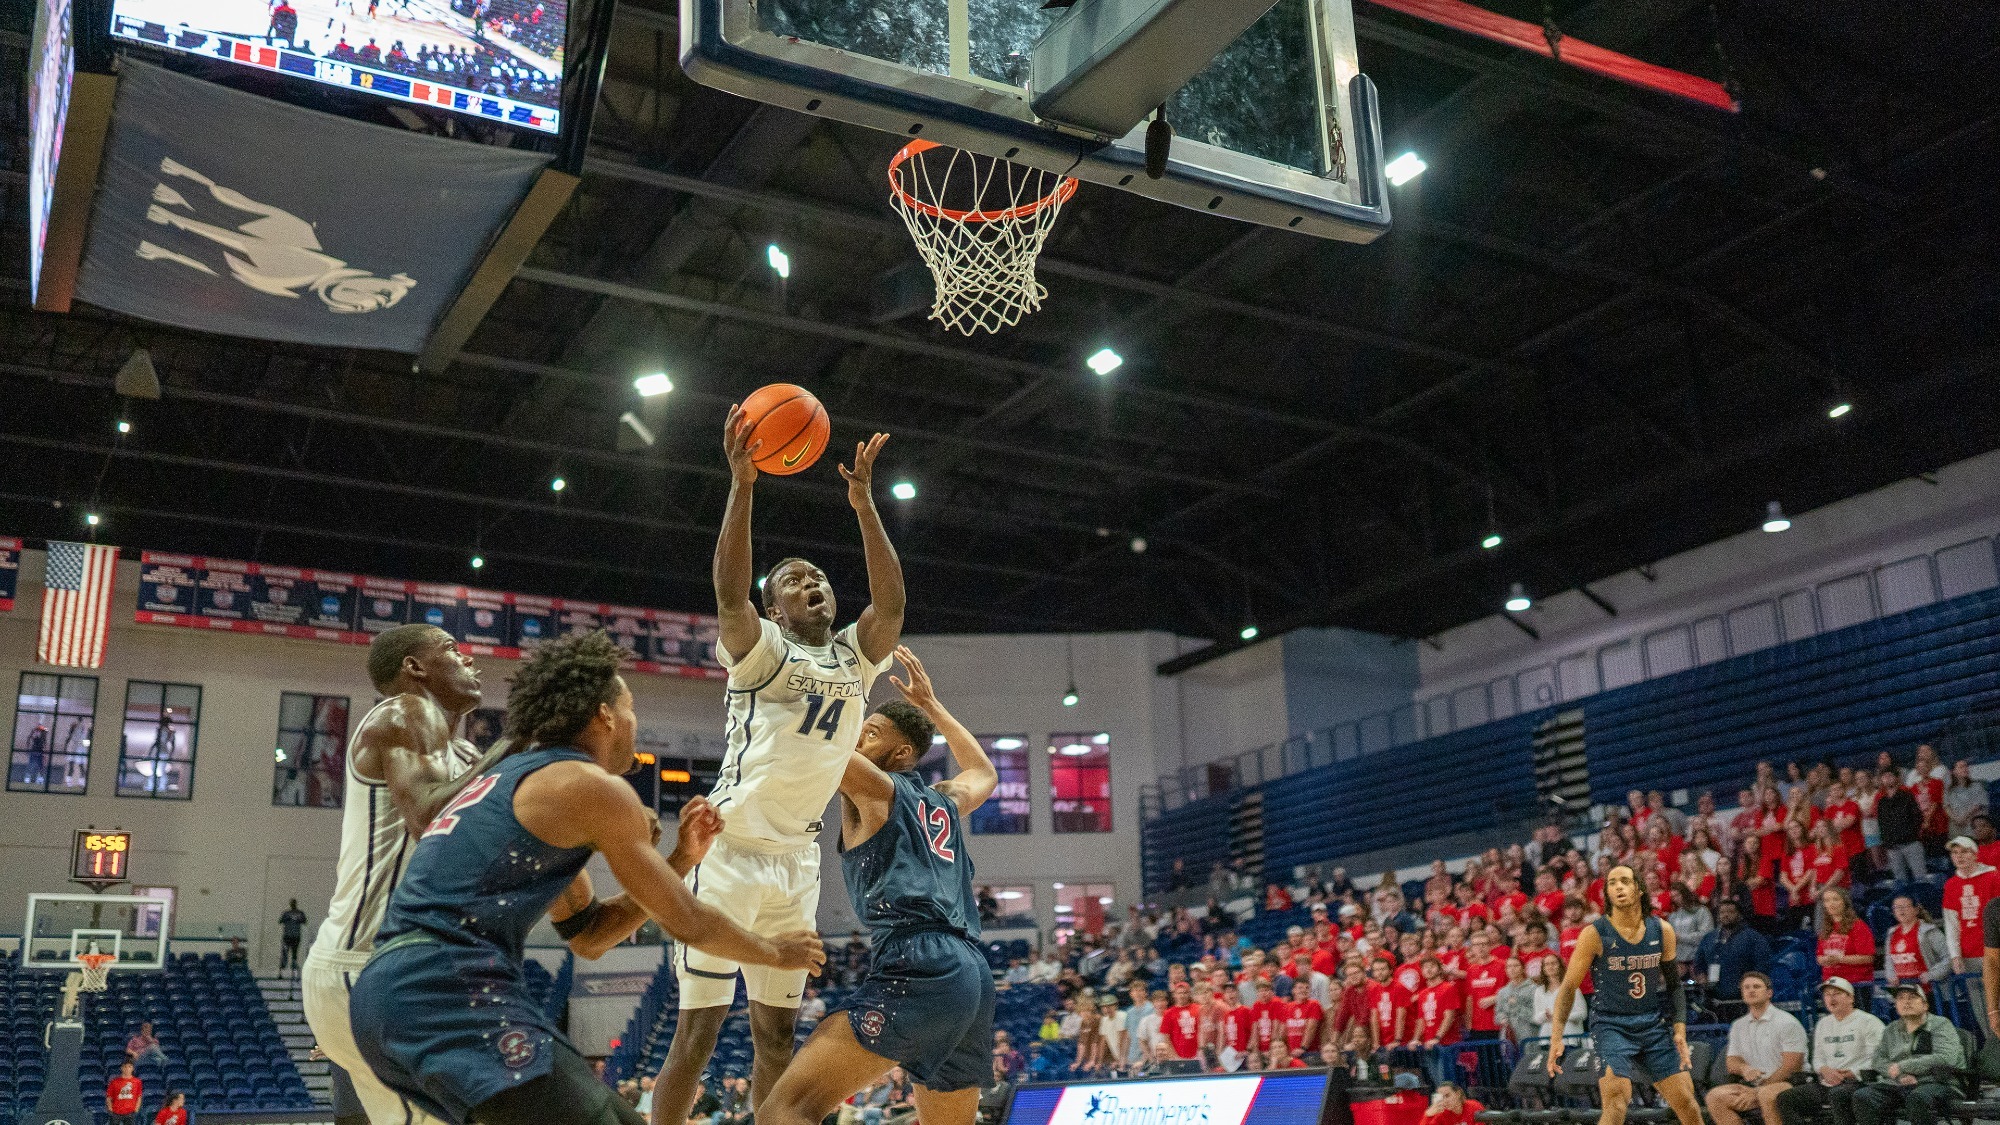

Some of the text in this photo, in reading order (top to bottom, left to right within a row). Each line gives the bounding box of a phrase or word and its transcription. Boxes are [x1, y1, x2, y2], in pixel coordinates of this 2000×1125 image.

[797, 694, 846, 741] 14
[86, 835, 127, 852] 15:56
[94, 852, 120, 875] 11
[1607, 955, 1626, 971] SC
[1628, 971, 1647, 1000] 3
